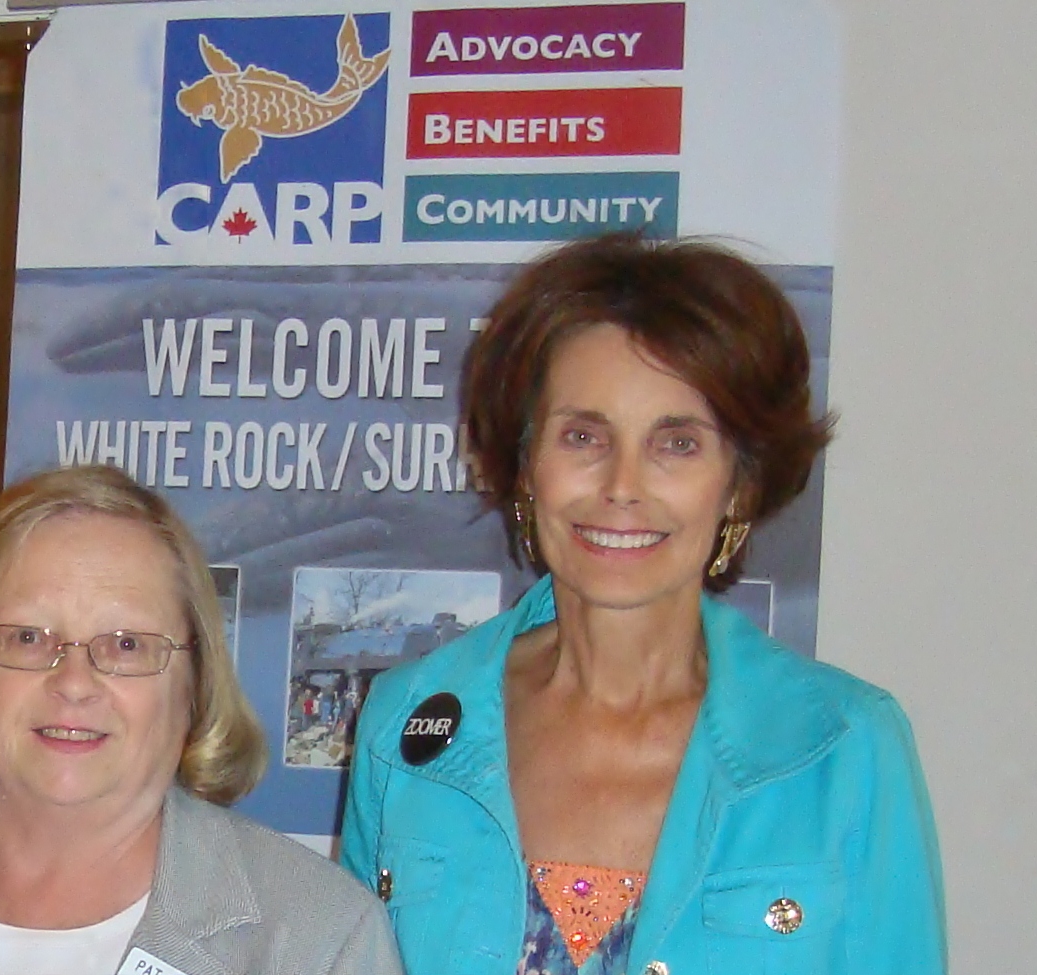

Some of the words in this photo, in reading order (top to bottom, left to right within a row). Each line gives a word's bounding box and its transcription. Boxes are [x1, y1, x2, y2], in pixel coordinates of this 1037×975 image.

[426, 32, 642, 63] ADVOCACY
[425, 114, 605, 145] BENEFITS
[156, 181, 382, 245] CARP
[416, 194, 662, 225] COMMUNITY
[142, 317, 445, 398] WELCOME
[56, 420, 191, 488] WHITE
[404, 718, 452, 736] ZOOMER
